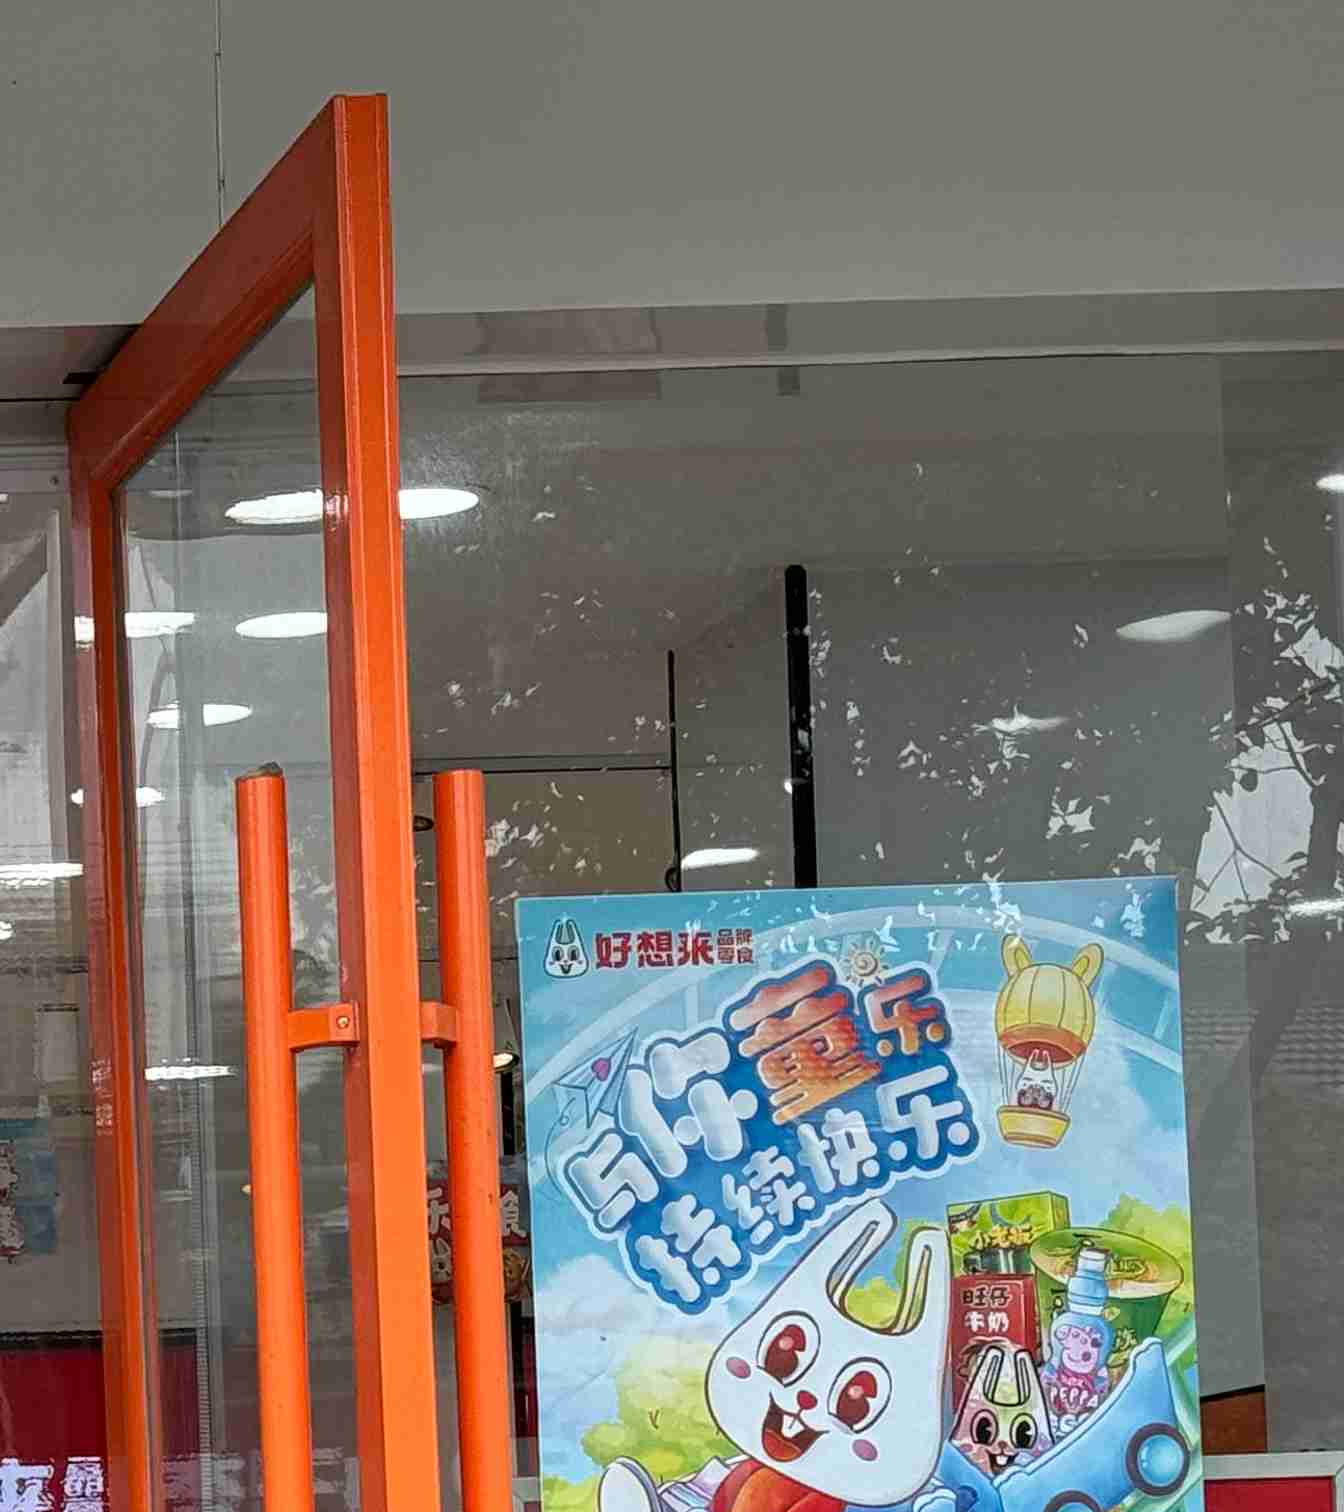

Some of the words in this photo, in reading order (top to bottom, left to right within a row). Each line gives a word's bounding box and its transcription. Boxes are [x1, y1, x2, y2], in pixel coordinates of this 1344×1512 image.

[595, 928, 714, 968] 好想来
[963, 1286, 1011, 1307] 旺仔
[965, 1311, 1009, 1333] 牛奶
